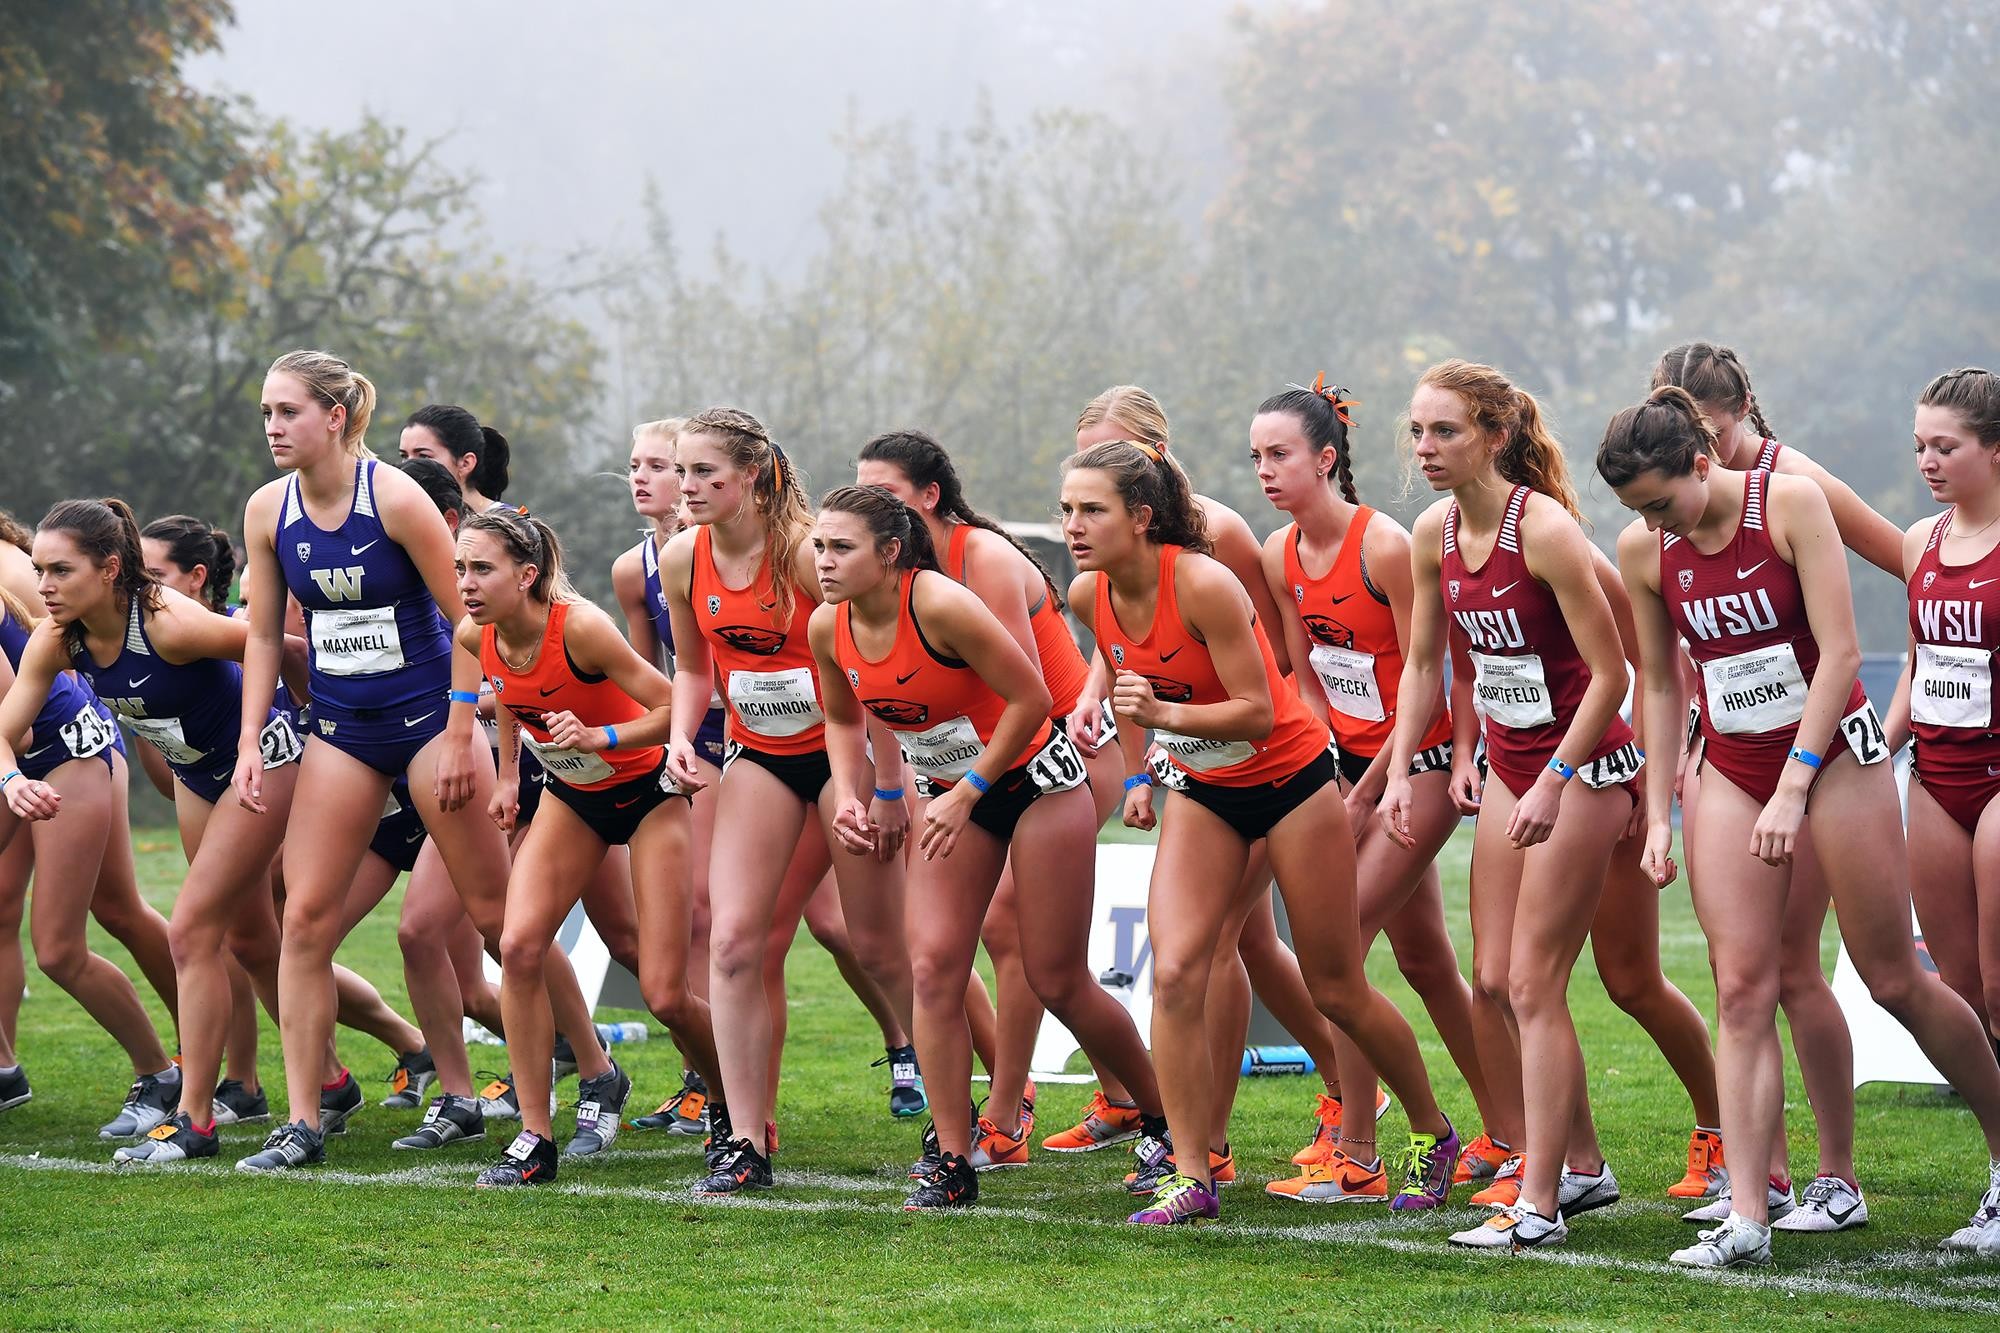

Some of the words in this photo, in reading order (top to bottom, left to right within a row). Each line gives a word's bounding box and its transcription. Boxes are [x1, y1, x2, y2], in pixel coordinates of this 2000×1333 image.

[310, 566, 365, 602] W
[1680, 588, 1779, 640] WSU
[1918, 600, 1984, 643] WSU
[1453, 608, 1525, 649] WSU
[323, 634, 389, 654] MAXWELL
[1727, 665, 1767, 679] CHAMPIONSHIPS
[1739, 661, 1755, 671] CROSS
[1755, 656, 1779, 667] COUNTRY
[777, 678, 798, 687] COUNTRY
[1477, 682, 1540, 704] BORTFELD
[1925, 680, 1971, 700] GAUDIN
[1722, 682, 1788, 712] HRUSKA
[738, 700, 812, 717] MCKINNON
[318, 719, 337, 735] W
[911, 744, 979, 768] CAVALLUZZO
[1036, 735, 1084, 788] 167
[1251, 1063, 1304, 1074] POWERADE
